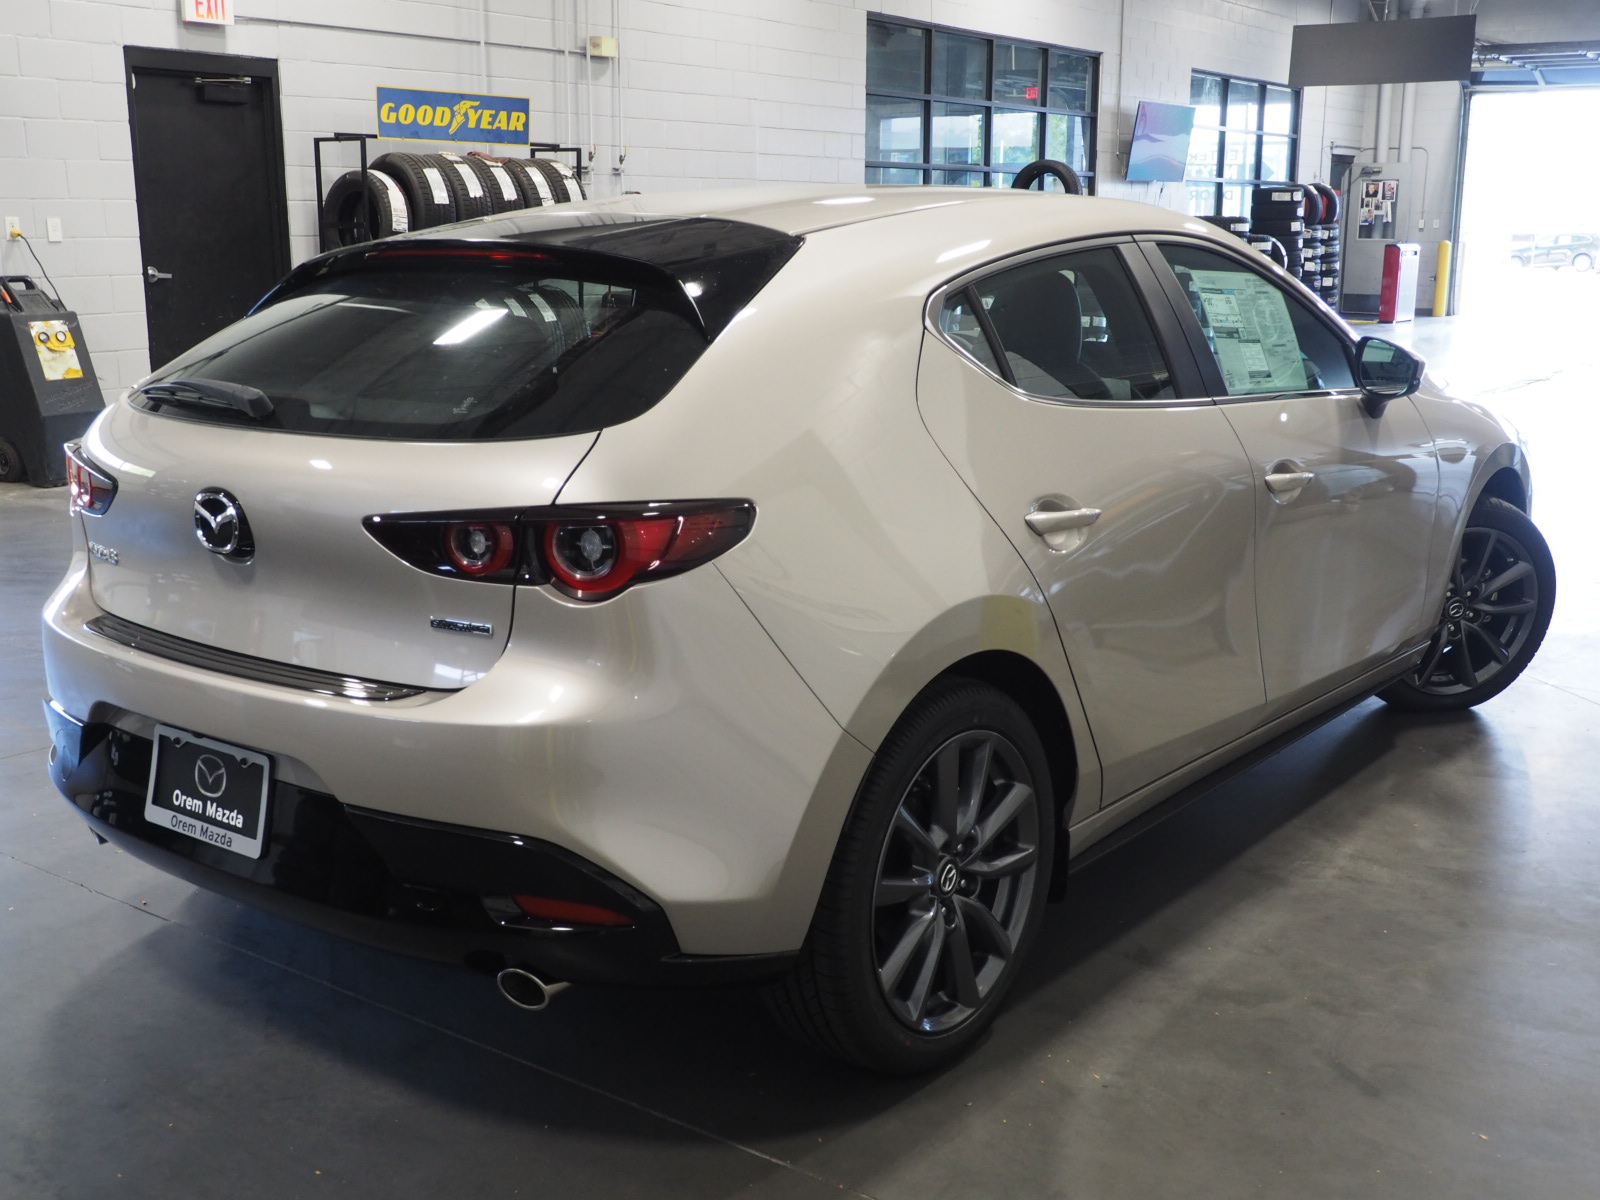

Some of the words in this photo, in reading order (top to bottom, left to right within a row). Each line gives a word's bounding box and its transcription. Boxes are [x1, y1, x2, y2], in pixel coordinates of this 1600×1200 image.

[172, 789, 203, 813] Orem
[206, 801, 243, 828] Mazda
[170, 815, 197, 835] Orem
[199, 824, 233, 848] Mazda
